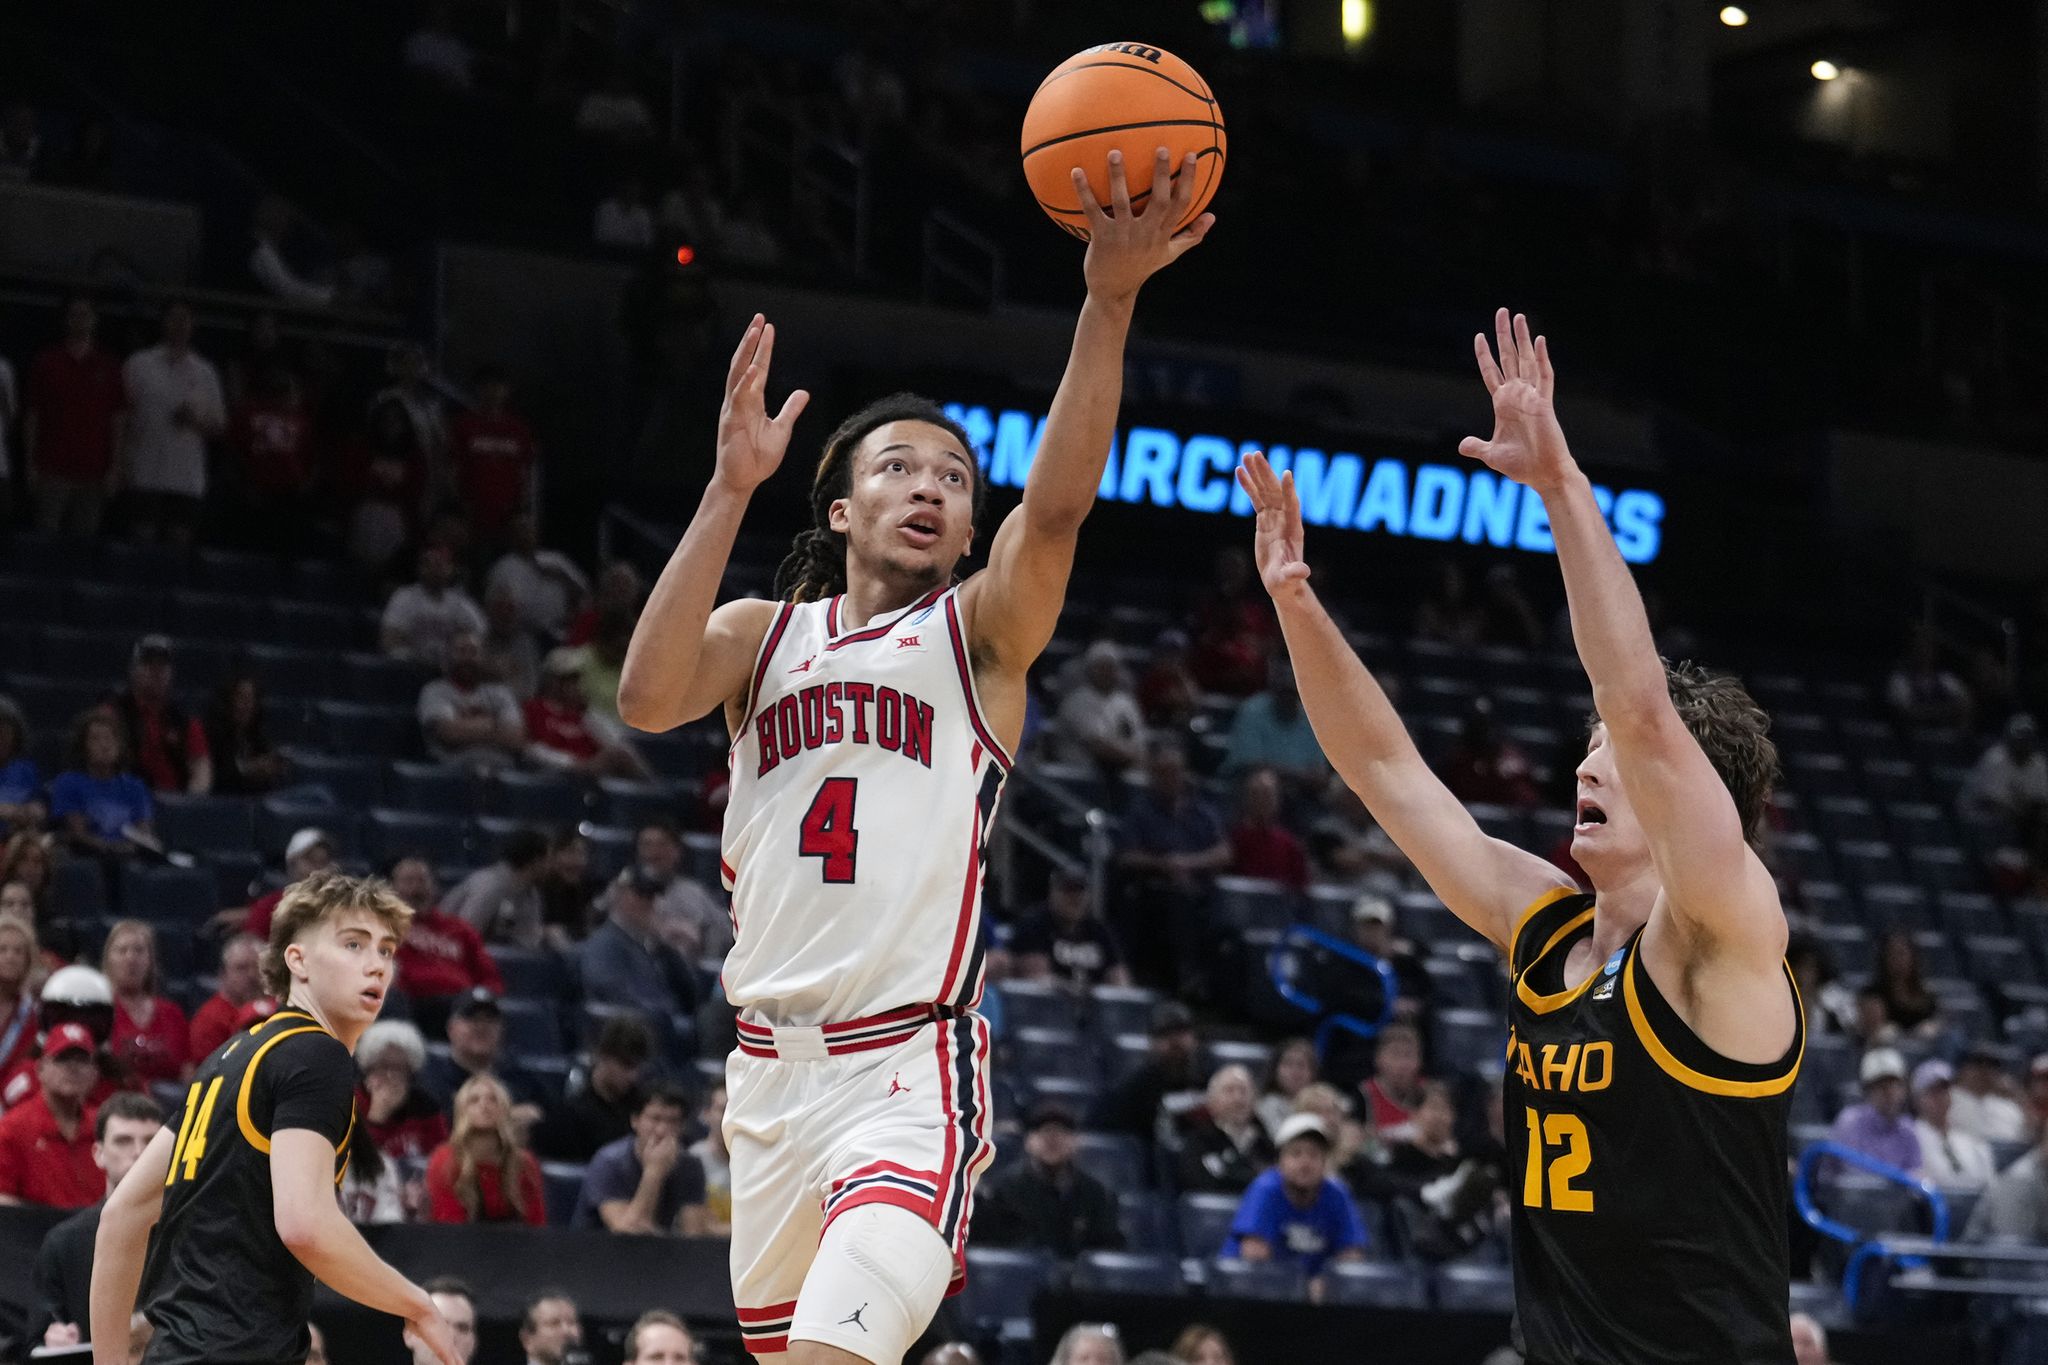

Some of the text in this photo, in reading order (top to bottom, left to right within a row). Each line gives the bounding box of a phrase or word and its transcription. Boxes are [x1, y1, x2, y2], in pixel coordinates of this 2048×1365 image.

[943, 403, 1664, 564] #MRCMADNES
[756, 682, 934, 779] HOUSTON
[799, 777, 858, 884] 4
[1505, 1024, 1614, 1092] AHO
[165, 1075, 225, 1186] 14
[1523, 1106, 1594, 1212] 12
